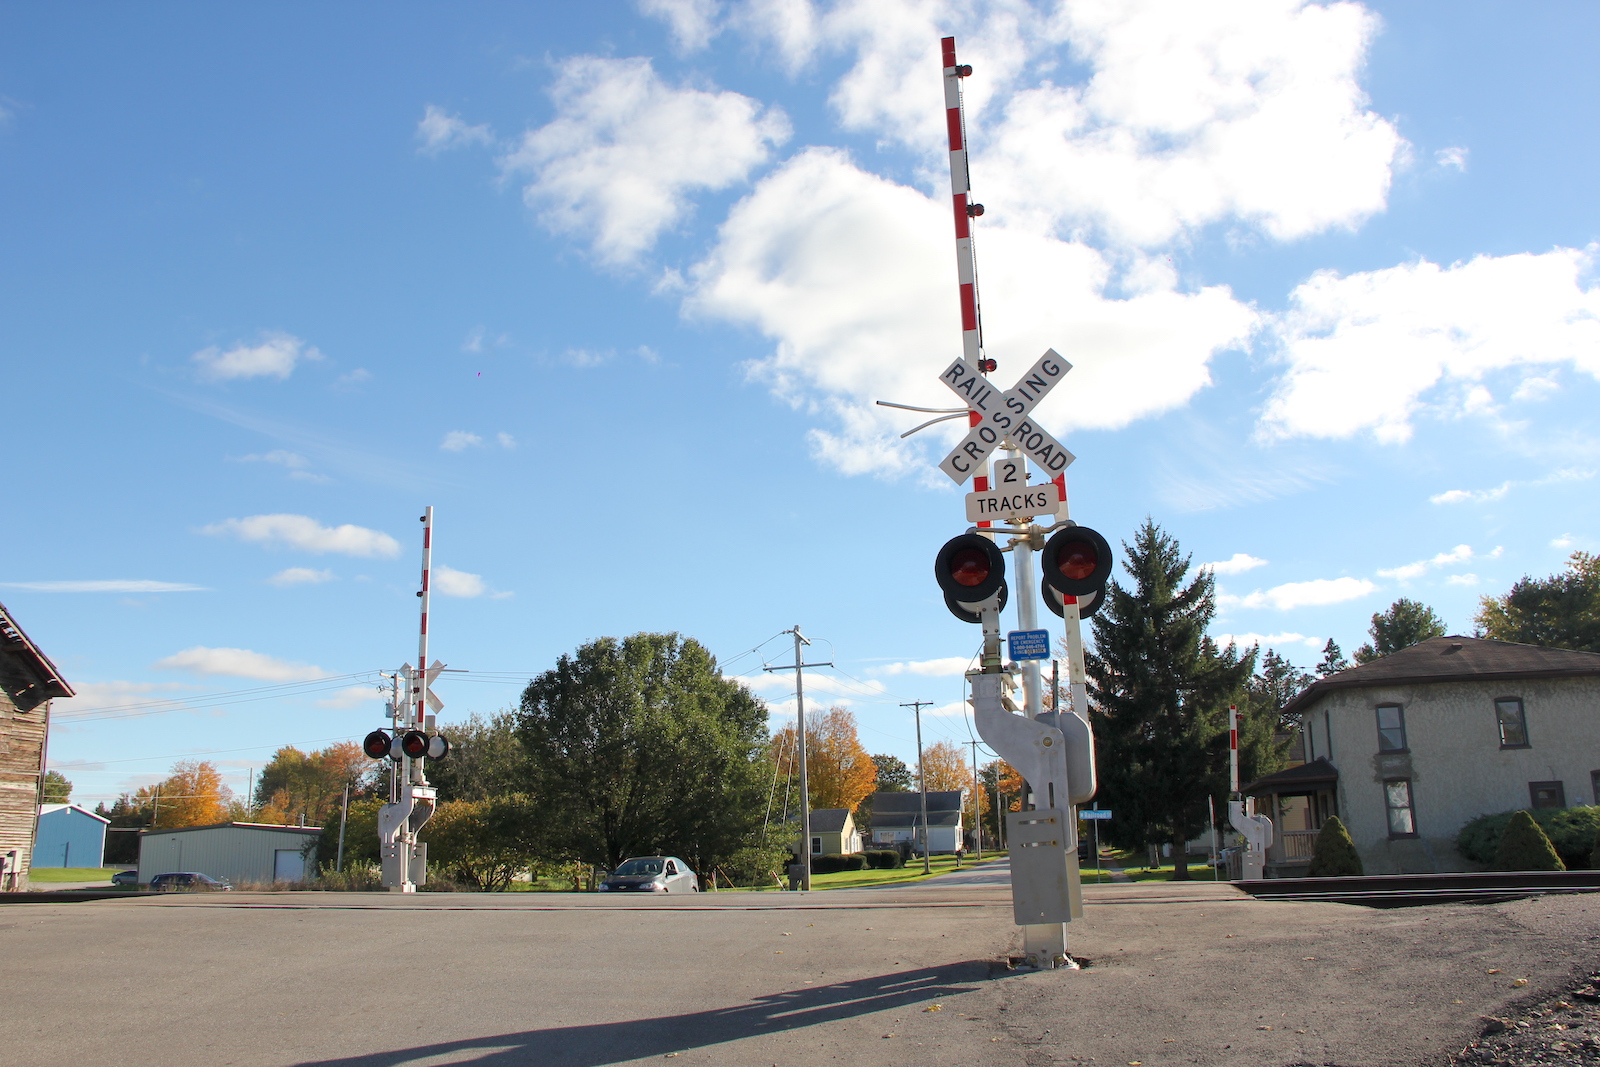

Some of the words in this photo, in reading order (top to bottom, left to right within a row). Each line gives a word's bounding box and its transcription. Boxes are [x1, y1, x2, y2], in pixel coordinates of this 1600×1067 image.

[945, 363, 992, 411] RAIL
[1012, 420, 1067, 471] ROAD
[951, 359, 1060, 473] CROSSING
[977, 492, 1047, 514] TRACKS
[1003, 464, 1017, 483] 2
